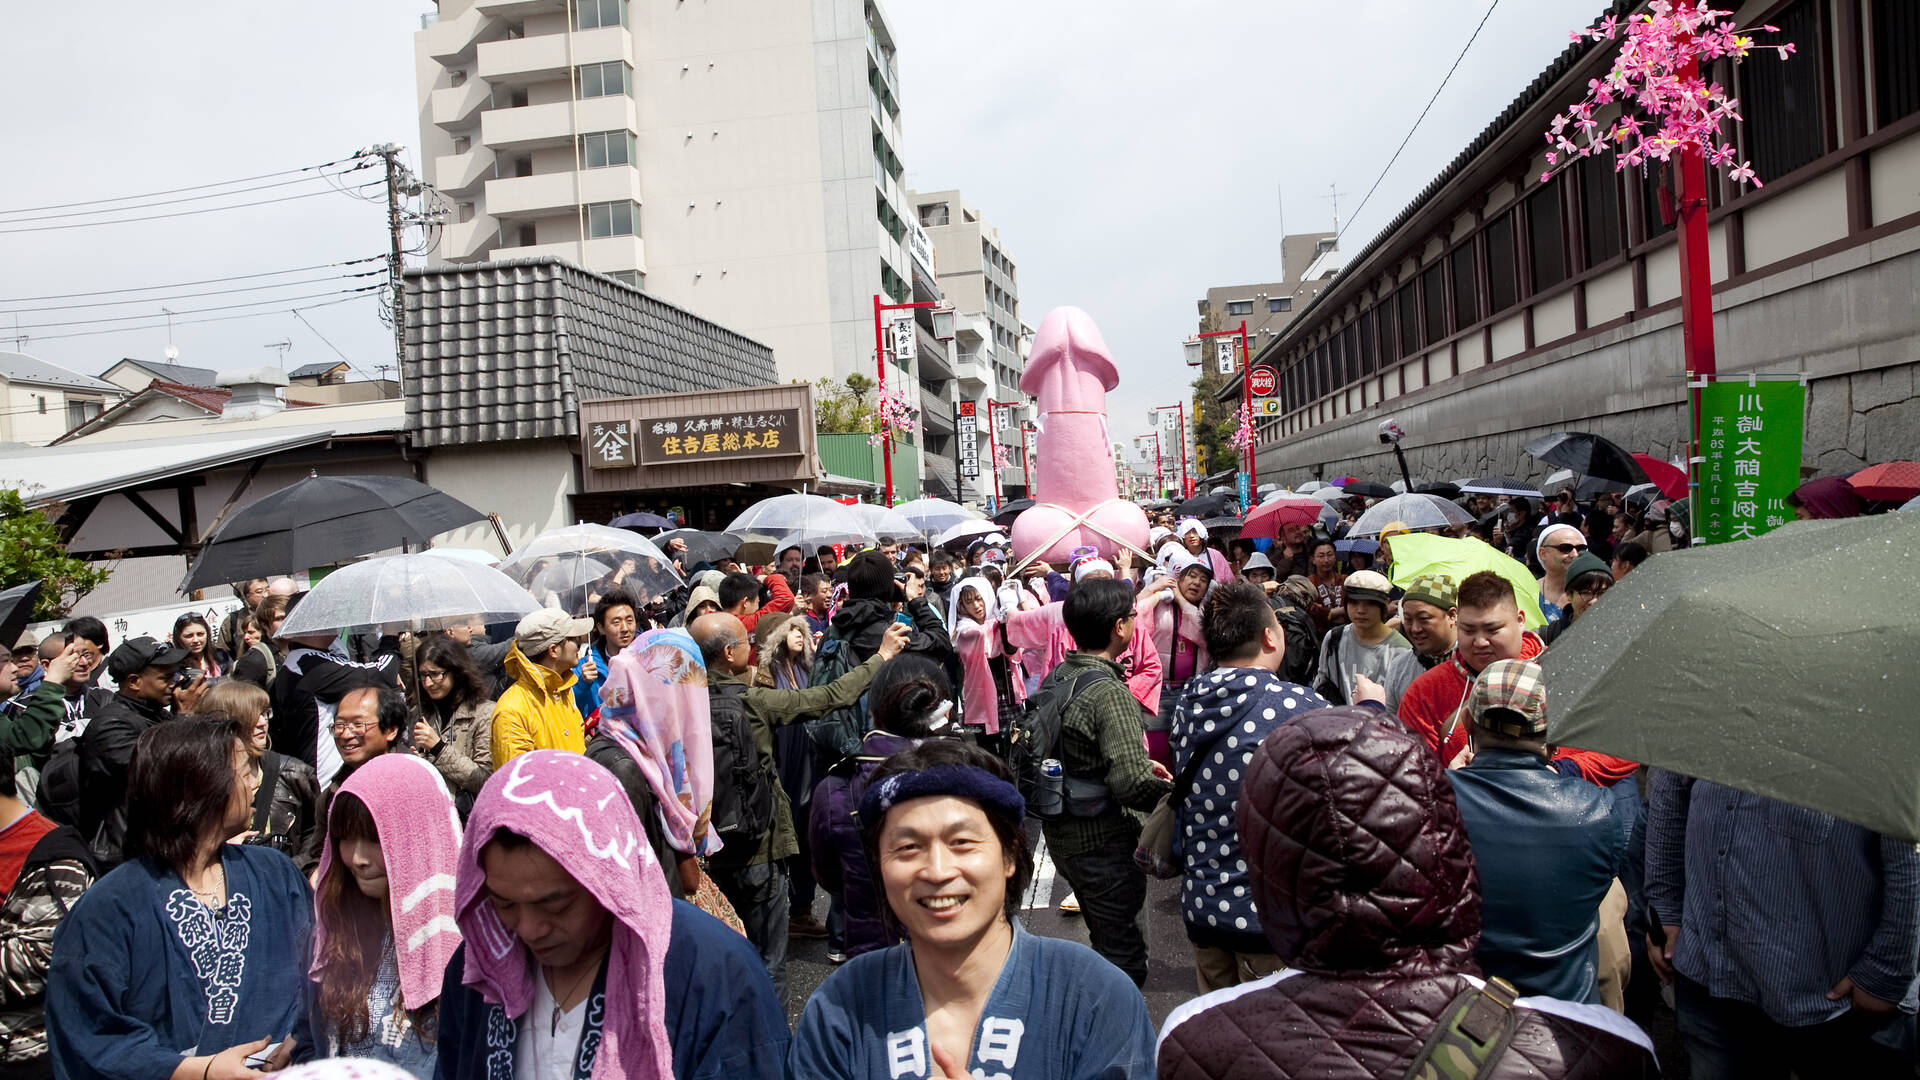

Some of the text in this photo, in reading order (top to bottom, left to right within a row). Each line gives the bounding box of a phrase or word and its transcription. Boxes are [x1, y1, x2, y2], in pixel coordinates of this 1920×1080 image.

[898, 321, 909, 356] 表参道
[1221, 344, 1230, 372] 表参道
[1252, 377, 1272, 388] 消火栓
[652, 421, 678, 434] 名物
[662, 429, 781, 456] 住吉屋総本店
[114, 618, 128, 633] 物
[971, 1016, 1025, 1080] 日
